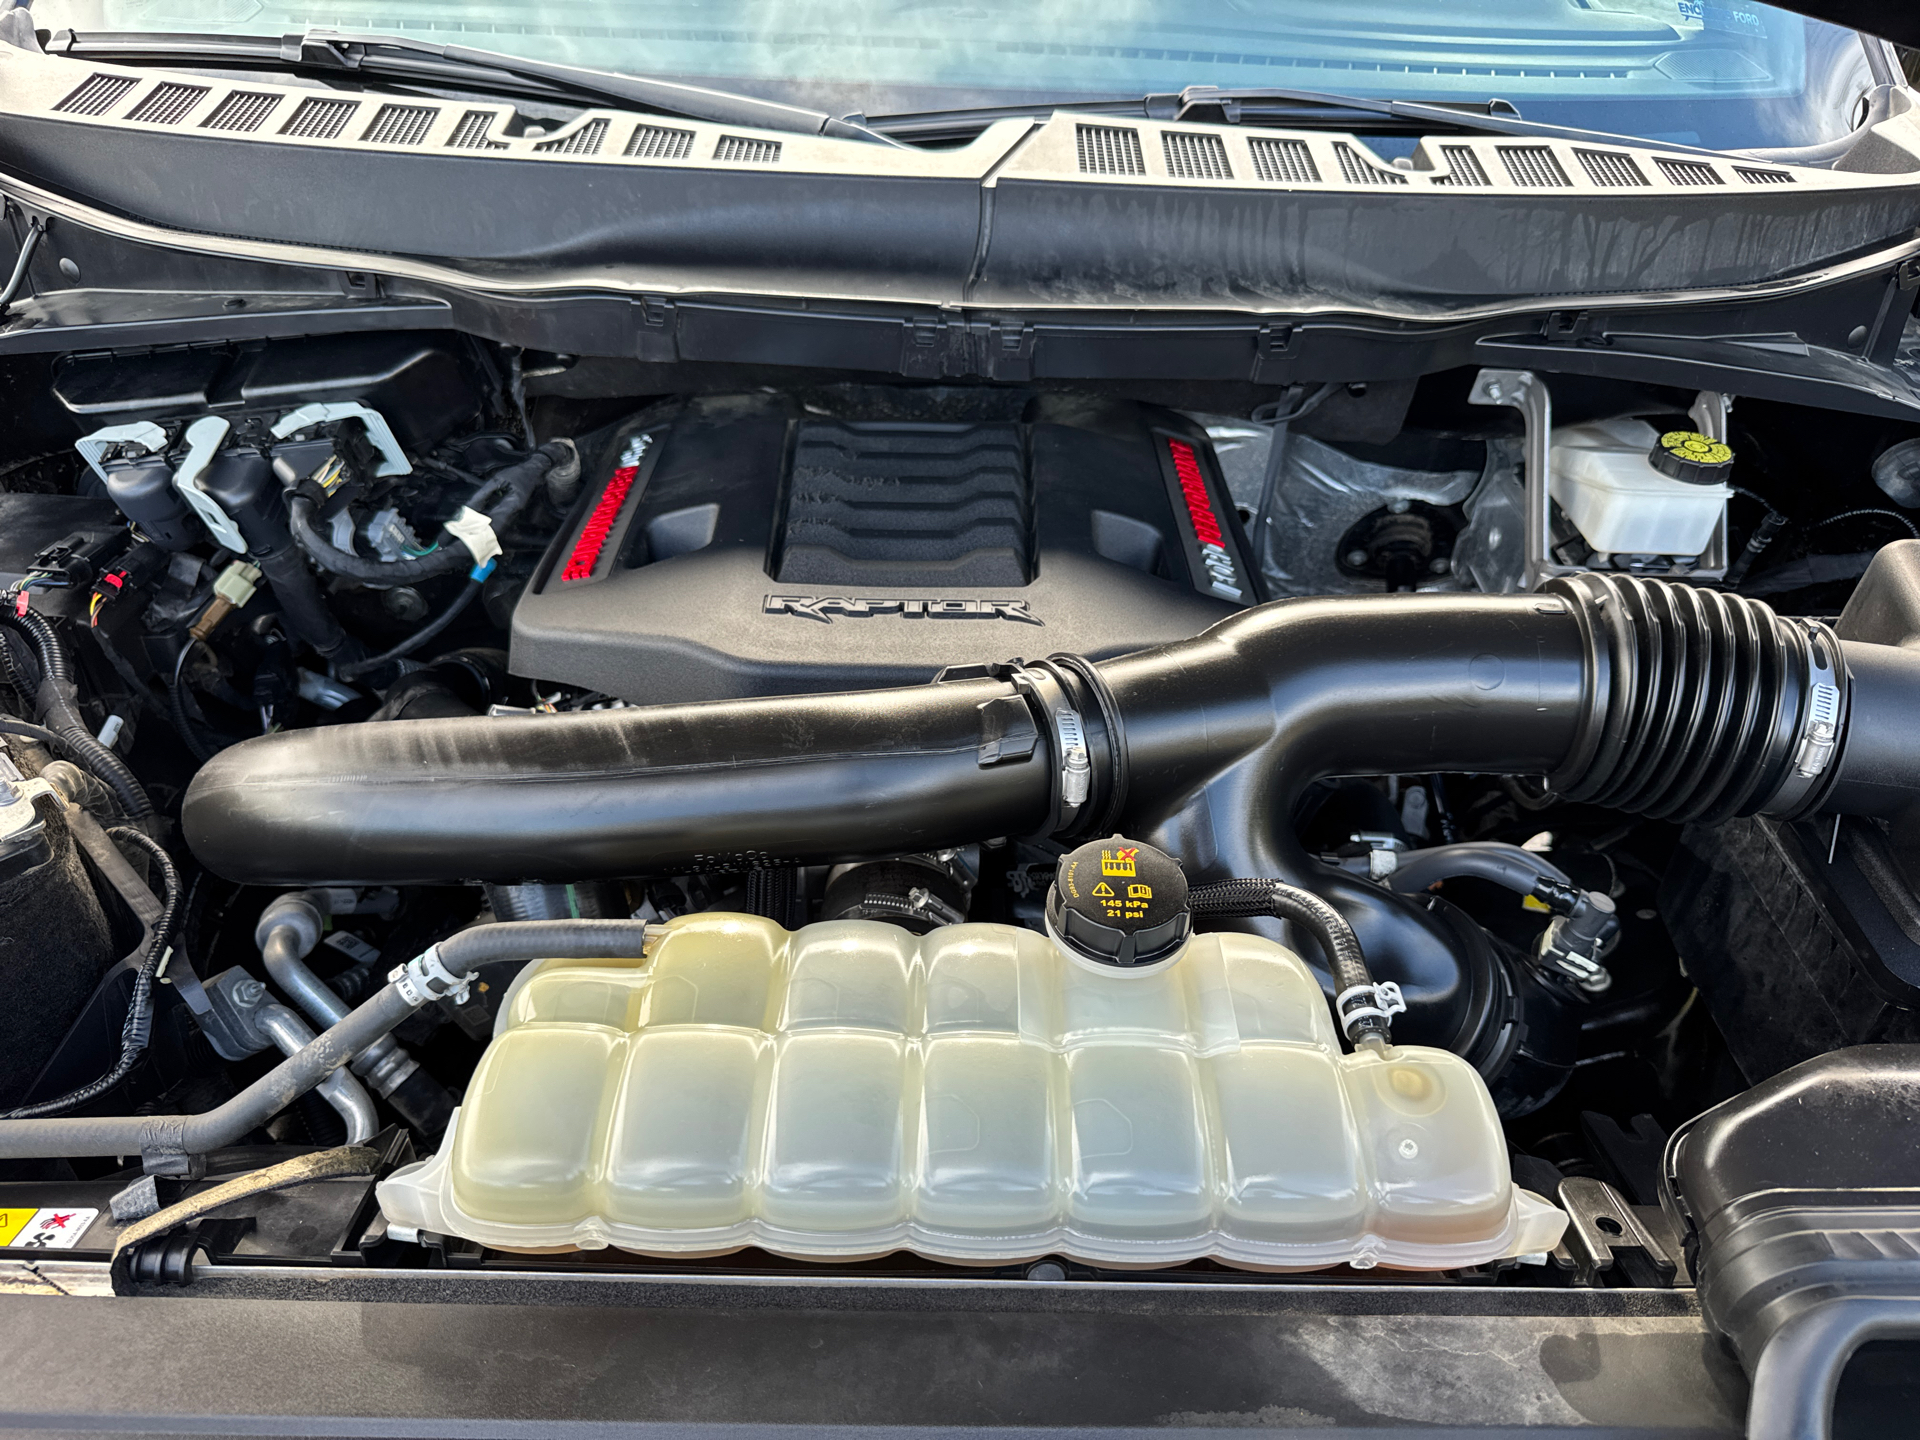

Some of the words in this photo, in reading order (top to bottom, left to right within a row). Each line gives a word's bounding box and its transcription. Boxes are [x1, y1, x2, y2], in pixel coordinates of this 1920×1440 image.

[1732, 11, 1759, 26] FORD
[762, 594, 1045, 627] RAPTOR
[1100, 900, 1122, 908] 145
[1126, 900, 1148, 908] kPa
[1125, 910, 1143, 918] psi
